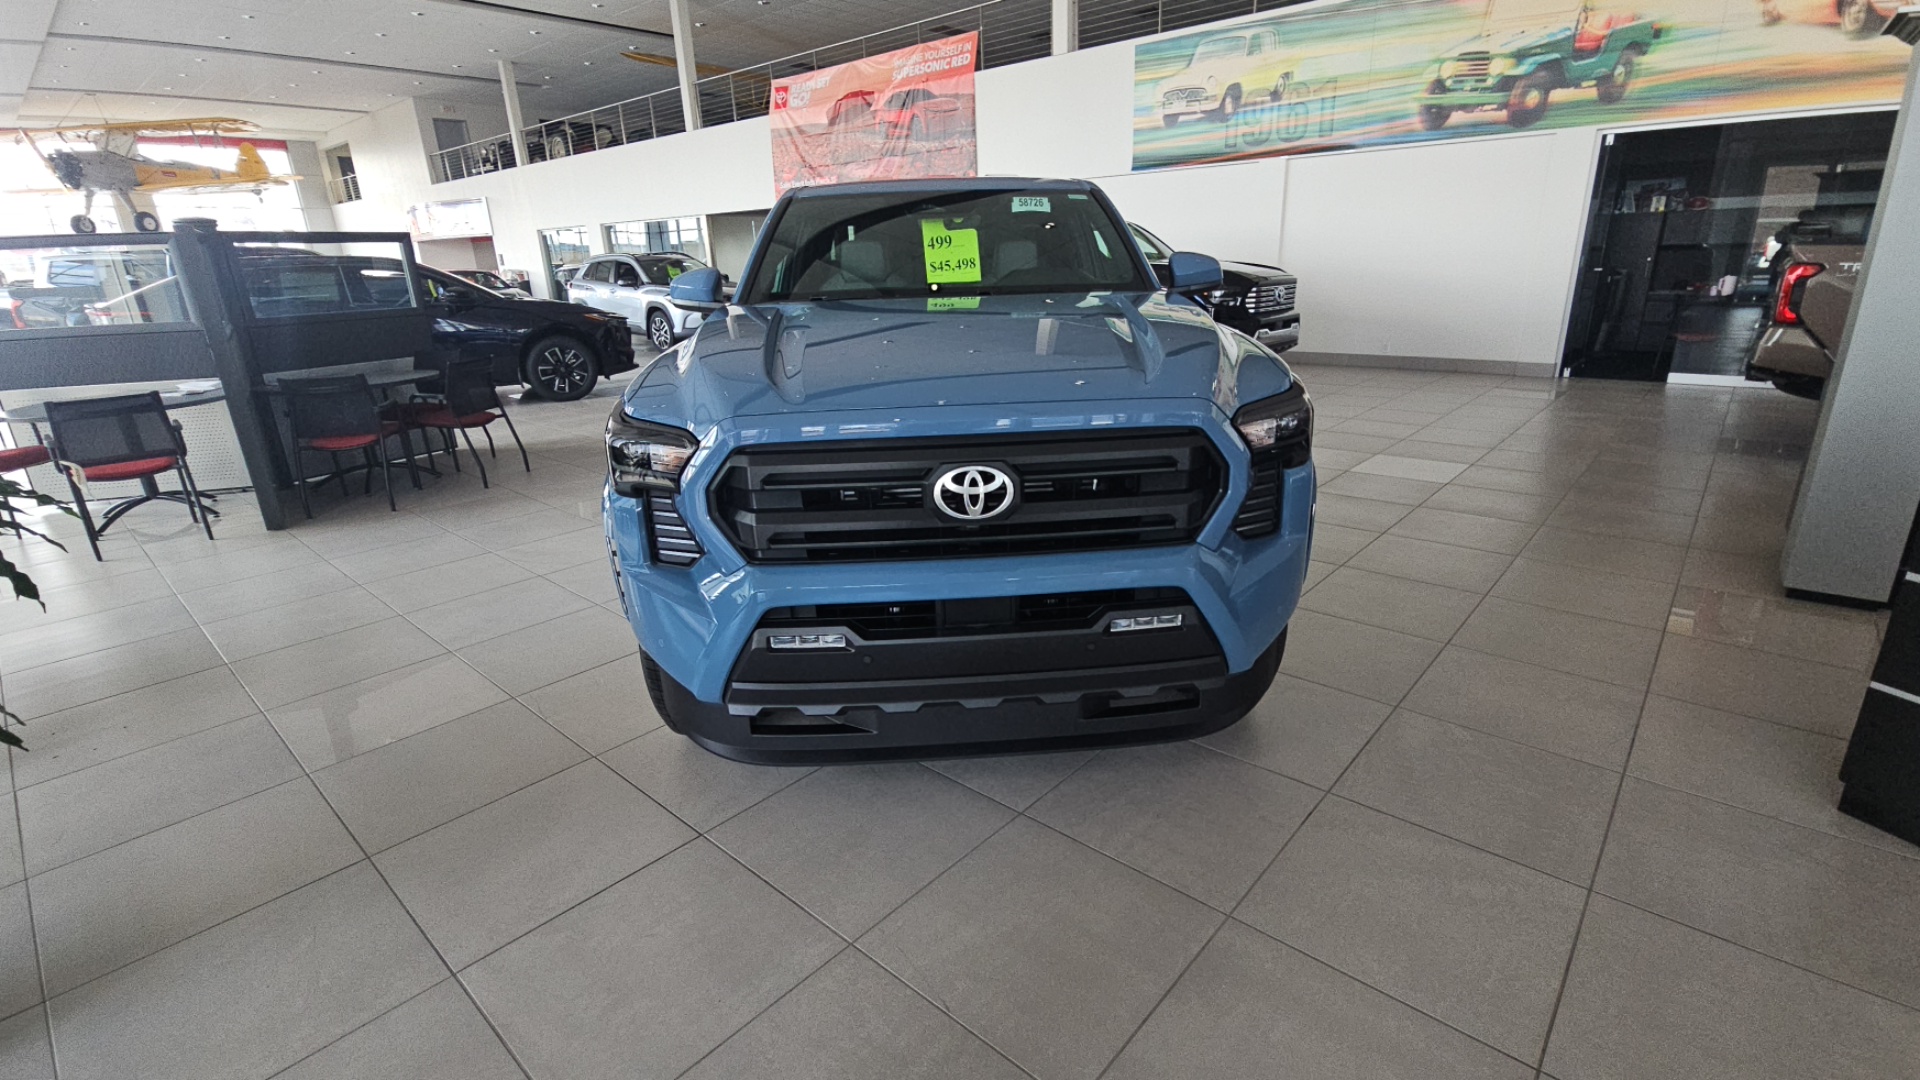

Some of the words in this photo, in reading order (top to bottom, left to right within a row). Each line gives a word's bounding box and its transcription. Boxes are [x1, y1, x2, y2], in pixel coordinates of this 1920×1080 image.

[925, 45, 962, 60] YOURSELF
[963, 42, 972, 51] IN
[892, 59, 950, 81] SUPERSONIC
[951, 54, 971, 68] RED
[790, 90, 811, 108] GO!
[1225, 79, 1338, 149] 1961
[1018, 198, 1044, 207] 58726
[927, 234, 952, 250] 499
[929, 257, 977, 274] $45,498
